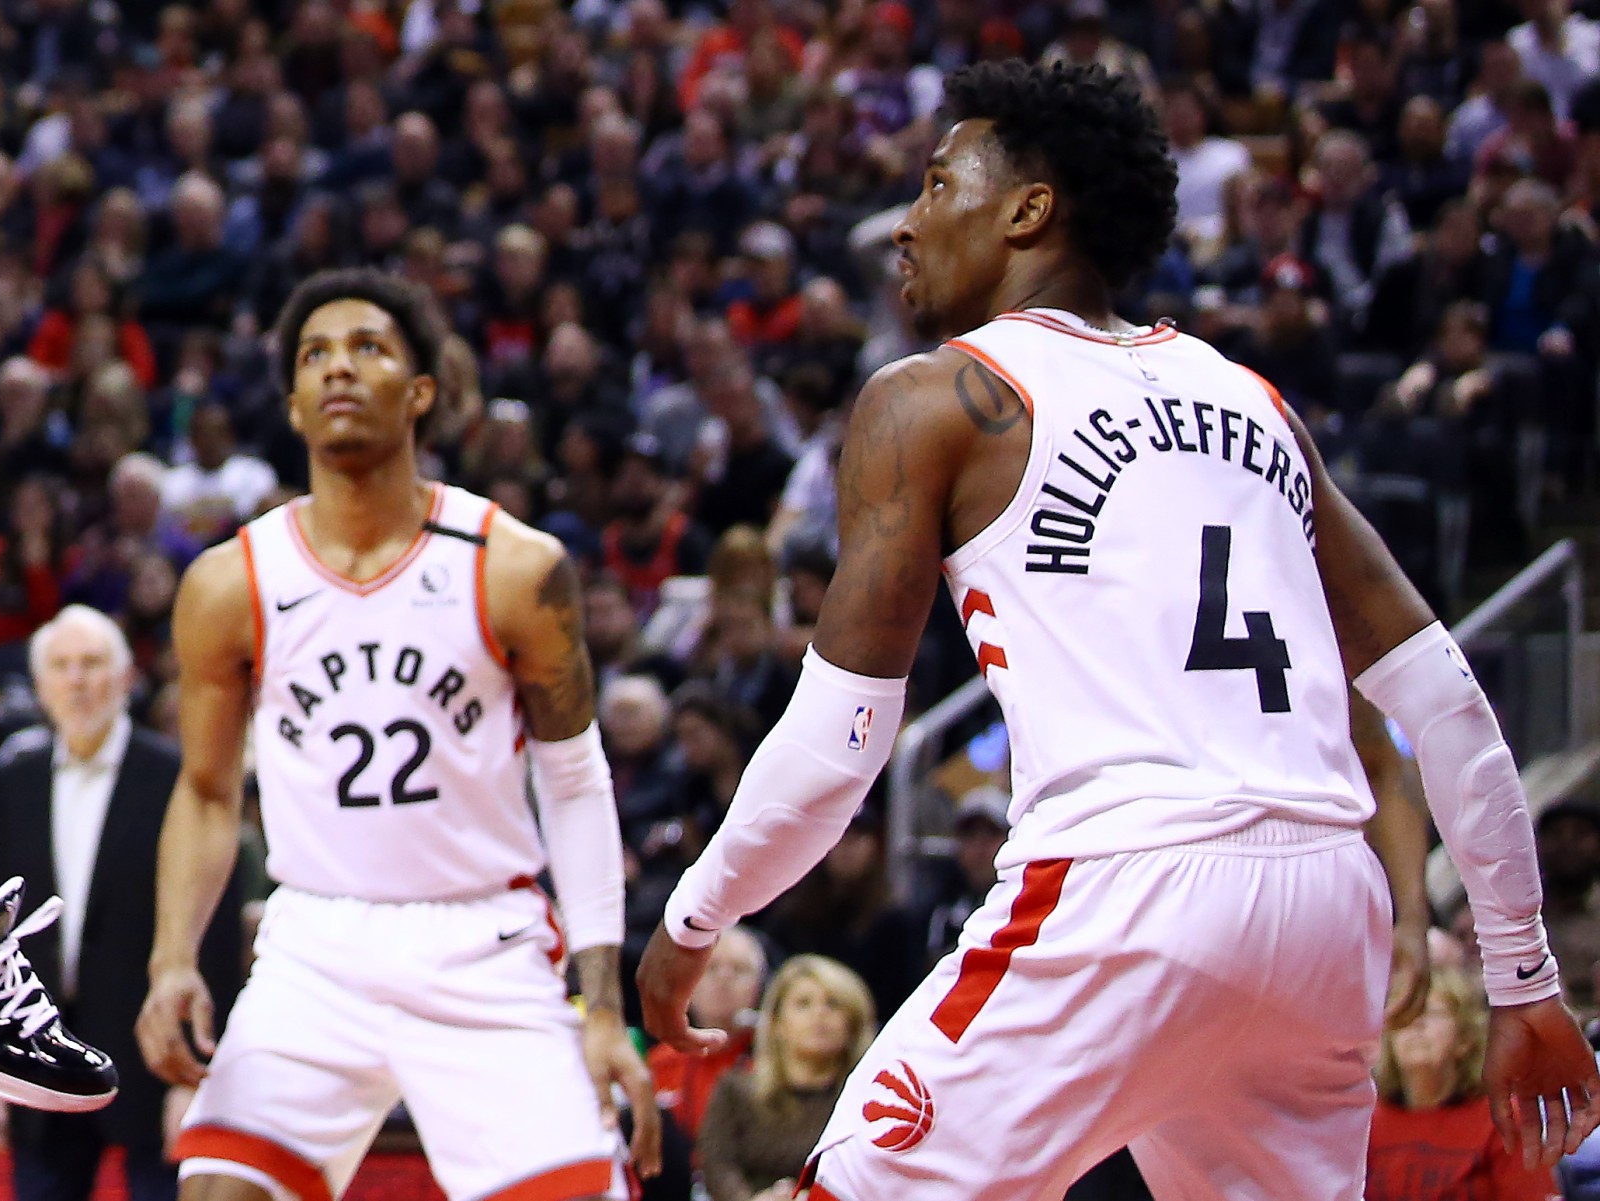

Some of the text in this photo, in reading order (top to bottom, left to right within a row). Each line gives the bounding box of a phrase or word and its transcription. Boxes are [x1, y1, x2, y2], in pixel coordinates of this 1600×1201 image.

[1025, 396, 1317, 575] HOLLIS-JEFFERSO
[1184, 524, 1292, 714] 4
[277, 641, 484, 750] RAPTORS
[329, 718, 440, 809] 22
